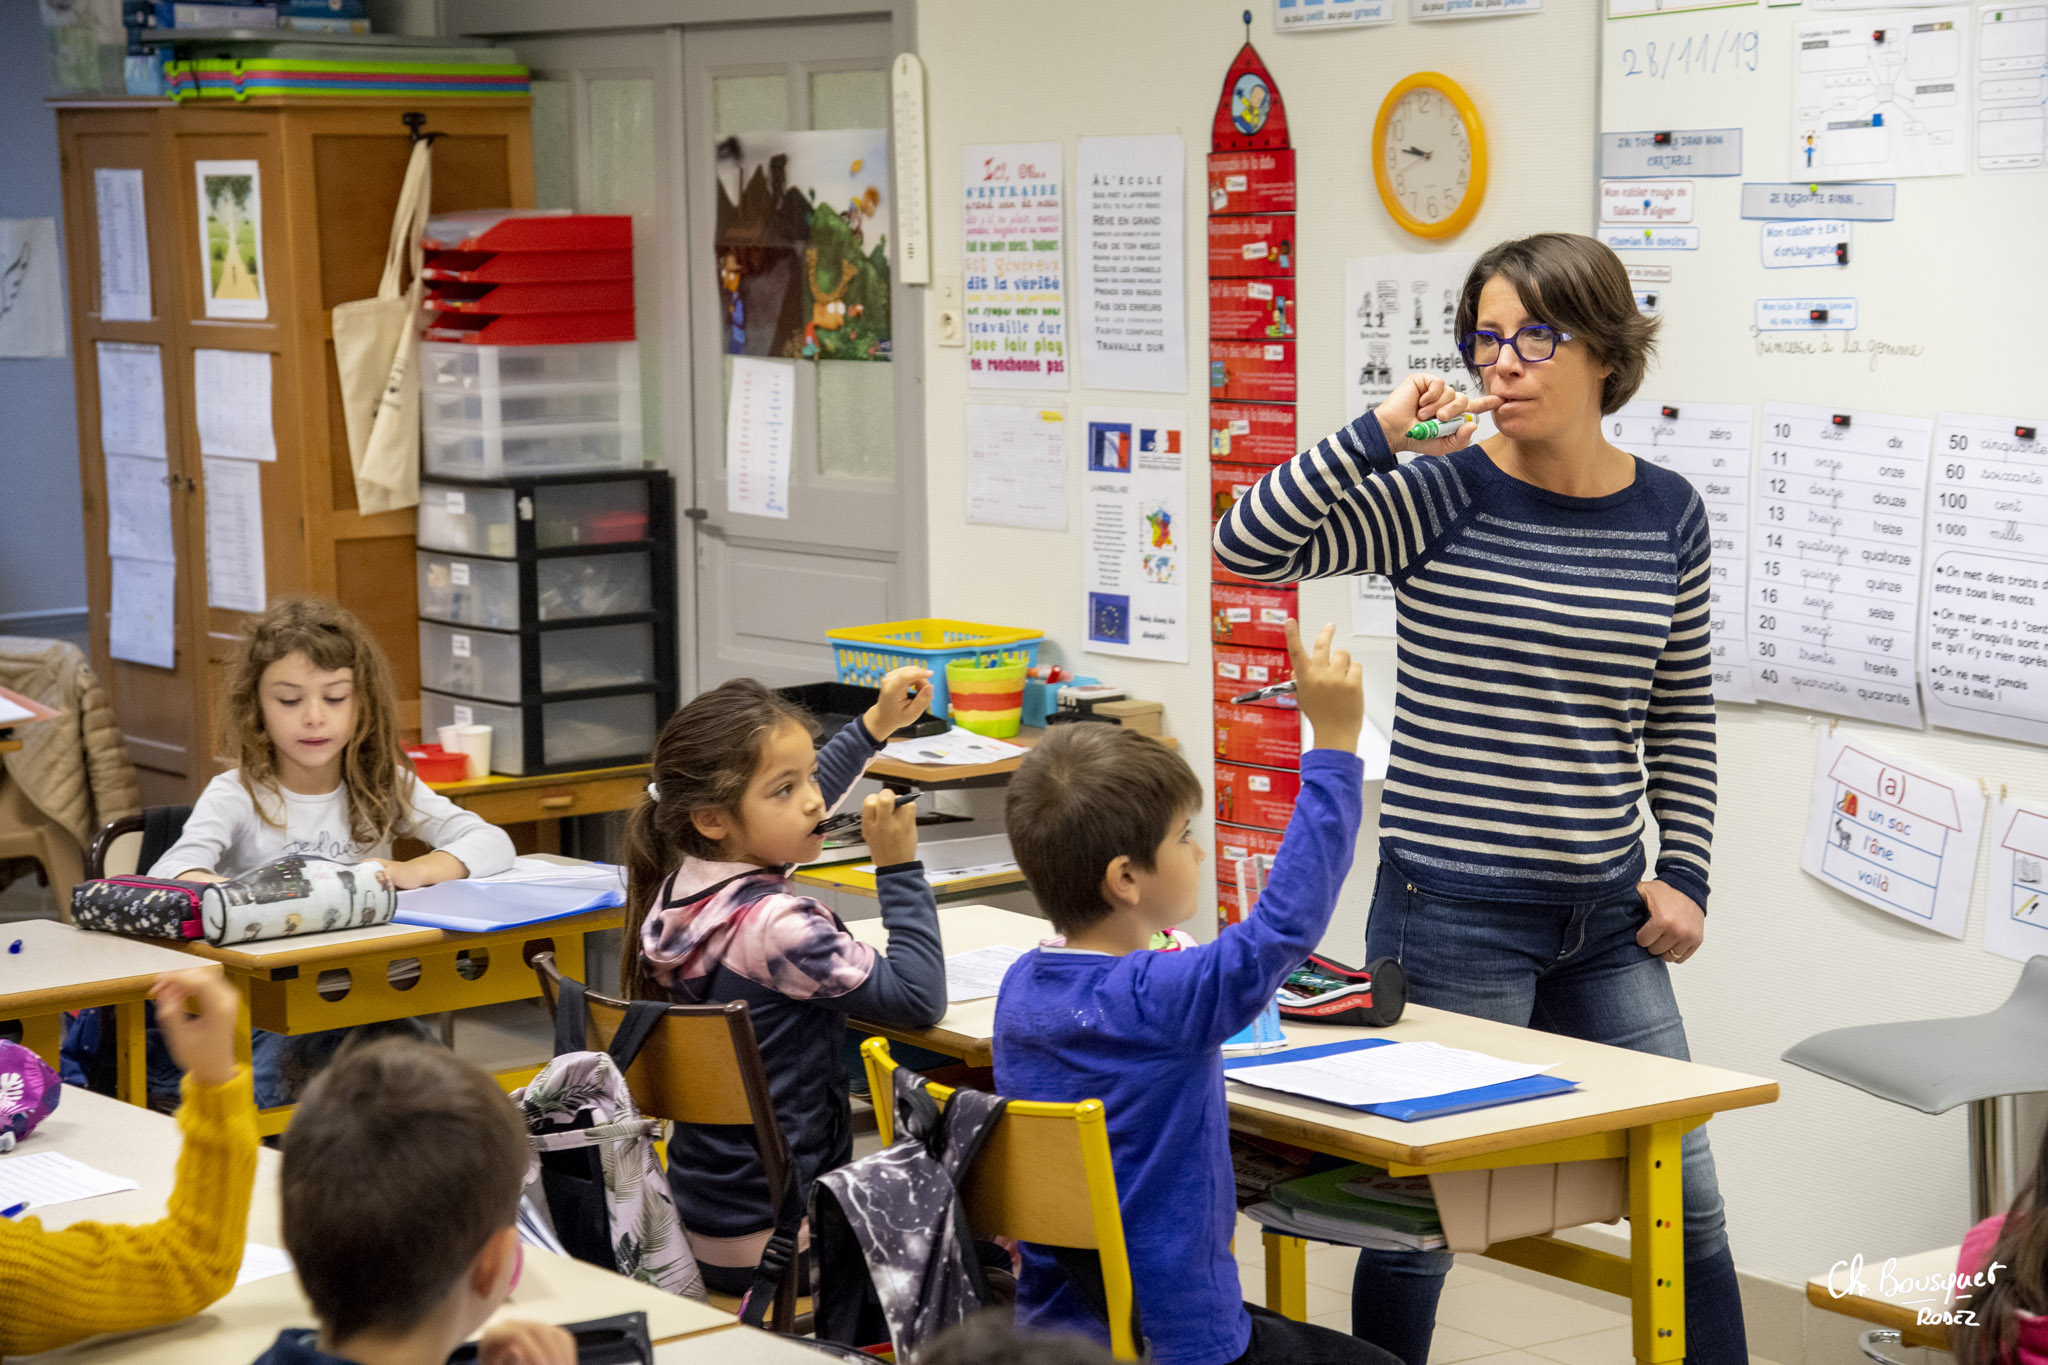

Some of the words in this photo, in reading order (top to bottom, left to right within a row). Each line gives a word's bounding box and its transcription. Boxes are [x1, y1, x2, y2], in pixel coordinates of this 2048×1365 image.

[1306, 10, 1324, 23] petit
[1338, 11, 1352, 21] plus
[1354, 7, 1381, 20] grand
[1446, 0, 1473, 12] grand
[1622, 30, 1759, 79] 28/11/19
[1417, 90, 1430, 114] 12
[1439, 98, 1444, 118] 1
[1391, 119, 1404, 142] 10
[1451, 114, 1461, 136] 2
[1388, 147, 1397, 169] 9
[1459, 139, 1470, 162] 3
[1395, 174, 1407, 196] 8
[1457, 169, 1467, 189] 4
[1410, 191, 1418, 213] 7
[1427, 196, 1439, 218] 6
[1444, 188, 1457, 210] 5
[967, 275, 989, 291] dit
[993, 275, 1008, 291] la
[1014, 275, 1061, 291] vérité
[968, 320, 1030, 335] travaille
[1037, 320, 1062, 335] dur
[968, 336, 998, 356] joue
[1004, 336, 1028, 352] fair
[1034, 336, 1064, 357] play
[1843, 329, 1862, 353] la
[970, 358, 983, 371] ne
[987, 356, 1042, 372] ronchonne
[1046, 359, 1065, 376] pas
[1408, 354, 1427, 370] Les
[1431, 352, 1466, 373] règles
[1613, 422, 1623, 438] 0
[1709, 428, 1732, 441] zéro
[1774, 423, 1791, 438] 10
[1887, 436, 1904, 450] dix
[1949, 434, 1968, 450] 50
[1712, 458, 1725, 468] un
[1771, 451, 1788, 466] 11
[1879, 466, 1905, 479] onze
[1946, 463, 1965, 480] 60
[1706, 482, 1730, 495] deux
[1770, 478, 1787, 494] 12
[1873, 492, 1907, 508] douze
[1939, 492, 1967, 509] 100
[1768, 505, 1786, 521] 13
[1873, 520, 1903, 536] treize
[1766, 533, 1783, 549] 14
[1861, 548, 1911, 566] quatorze
[1764, 561, 1781, 576] 15
[1866, 579, 1902, 593] quinze
[1946, 565, 1960, 578] On
[1963, 570, 1983, 582] met
[1986, 572, 2004, 584] des
[2008, 575, 2039, 589] traits
[1935, 583, 1963, 596] entre
[1966, 587, 1988, 599] tous
[1991, 590, 2006, 602] les
[1761, 588, 1778, 604] 16
[1868, 607, 1895, 620] seize
[1941, 608, 1955, 620] On
[1958, 613, 1977, 624] met
[1981, 617, 1993, 626] un
[2011, 619, 2018, 630] à
[1759, 614, 1776, 631] 20
[1868, 635, 1894, 652] vingt
[2017, 637, 2039, 650] sont
[1759, 641, 1776, 658] 30
[1864, 660, 1898, 678] trente
[1931, 640, 1942, 650] et
[1985, 650, 1992, 659] a
[1994, 650, 2015, 663] rien
[1761, 669, 1778, 684] 40
[1857, 688, 1911, 706] quarante
[1939, 665, 1953, 677] On
[1956, 670, 1968, 680] ne
[1971, 672, 1991, 685] met
[1993, 675, 2028, 691] jamais
[1933, 680, 1945, 692] de
[1963, 686, 1970, 696] à
[1973, 688, 1995, 701] mille
[1877, 767, 1906, 805] (a)
[1868, 808, 1884, 825] un
[1888, 816, 1912, 836] sac
[1863, 834, 1894, 861] l'âne
[1858, 868, 1890, 893] voilà
